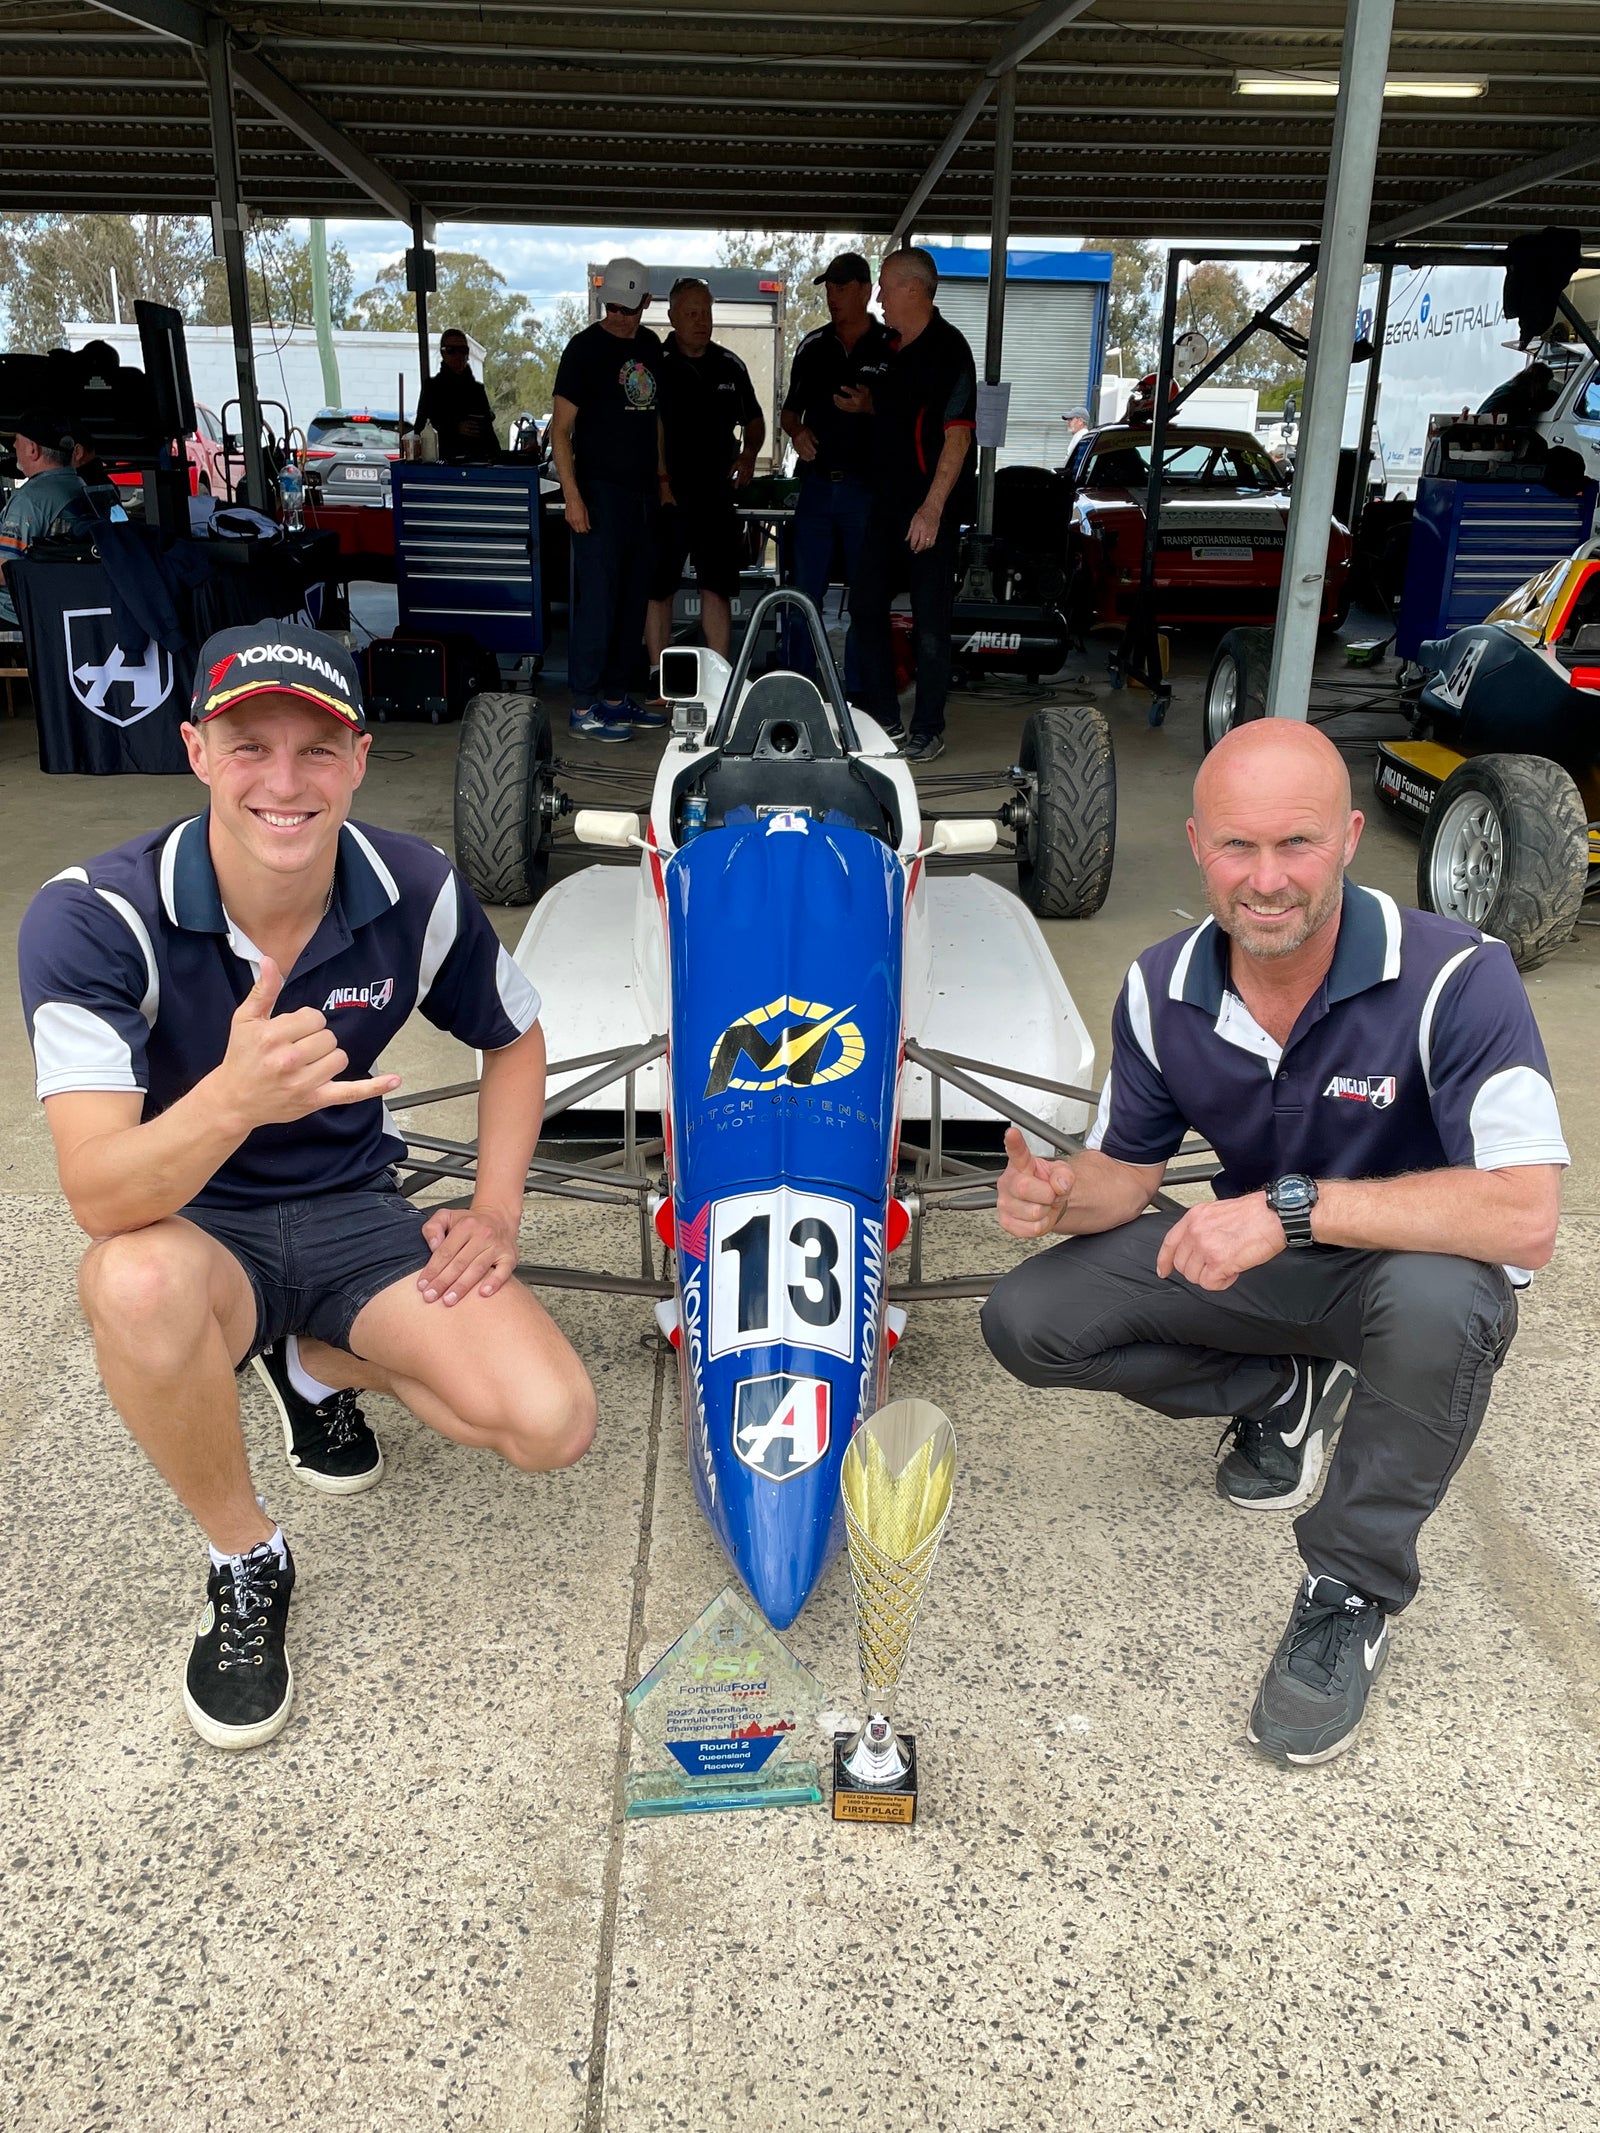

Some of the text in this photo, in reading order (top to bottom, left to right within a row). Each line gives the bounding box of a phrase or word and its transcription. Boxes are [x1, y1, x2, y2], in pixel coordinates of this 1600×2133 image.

[1385, 320, 1420, 346] EGRA
[1161, 535, 1284, 546] TRANSPORTHARDWARE.COM.AU
[960, 631, 1021, 653] ANGLO
[237, 644, 351, 697] YOKOHAMA
[1401, 775, 1429, 801] Formula
[322, 987, 369, 1011] ANGLO
[1322, 1076, 1368, 1097] ANGLO
[716, 1108, 847, 1133] MOTORSPORT
[771, 1093, 881, 1131] GATENBY
[721, 1214, 842, 1334] 13
[856, 1217, 883, 1424] YOKOHAMA
[683, 1264, 717, 1508] YOKOHAMA
[688, 1649, 765, 1680] 1st
[666, 1716, 708, 1725] Formula
[738, 1713, 762, 1721] 1600
[697, 1706, 748, 1715] Australian
[666, 1722, 739, 1733] Championship
[698, 1751, 751, 1762] Queensland
[700, 1741, 750, 1752] Round 2
[704, 1762, 745, 1771] Raceway
[842, 1805, 905, 1816] FIRST PLACE
